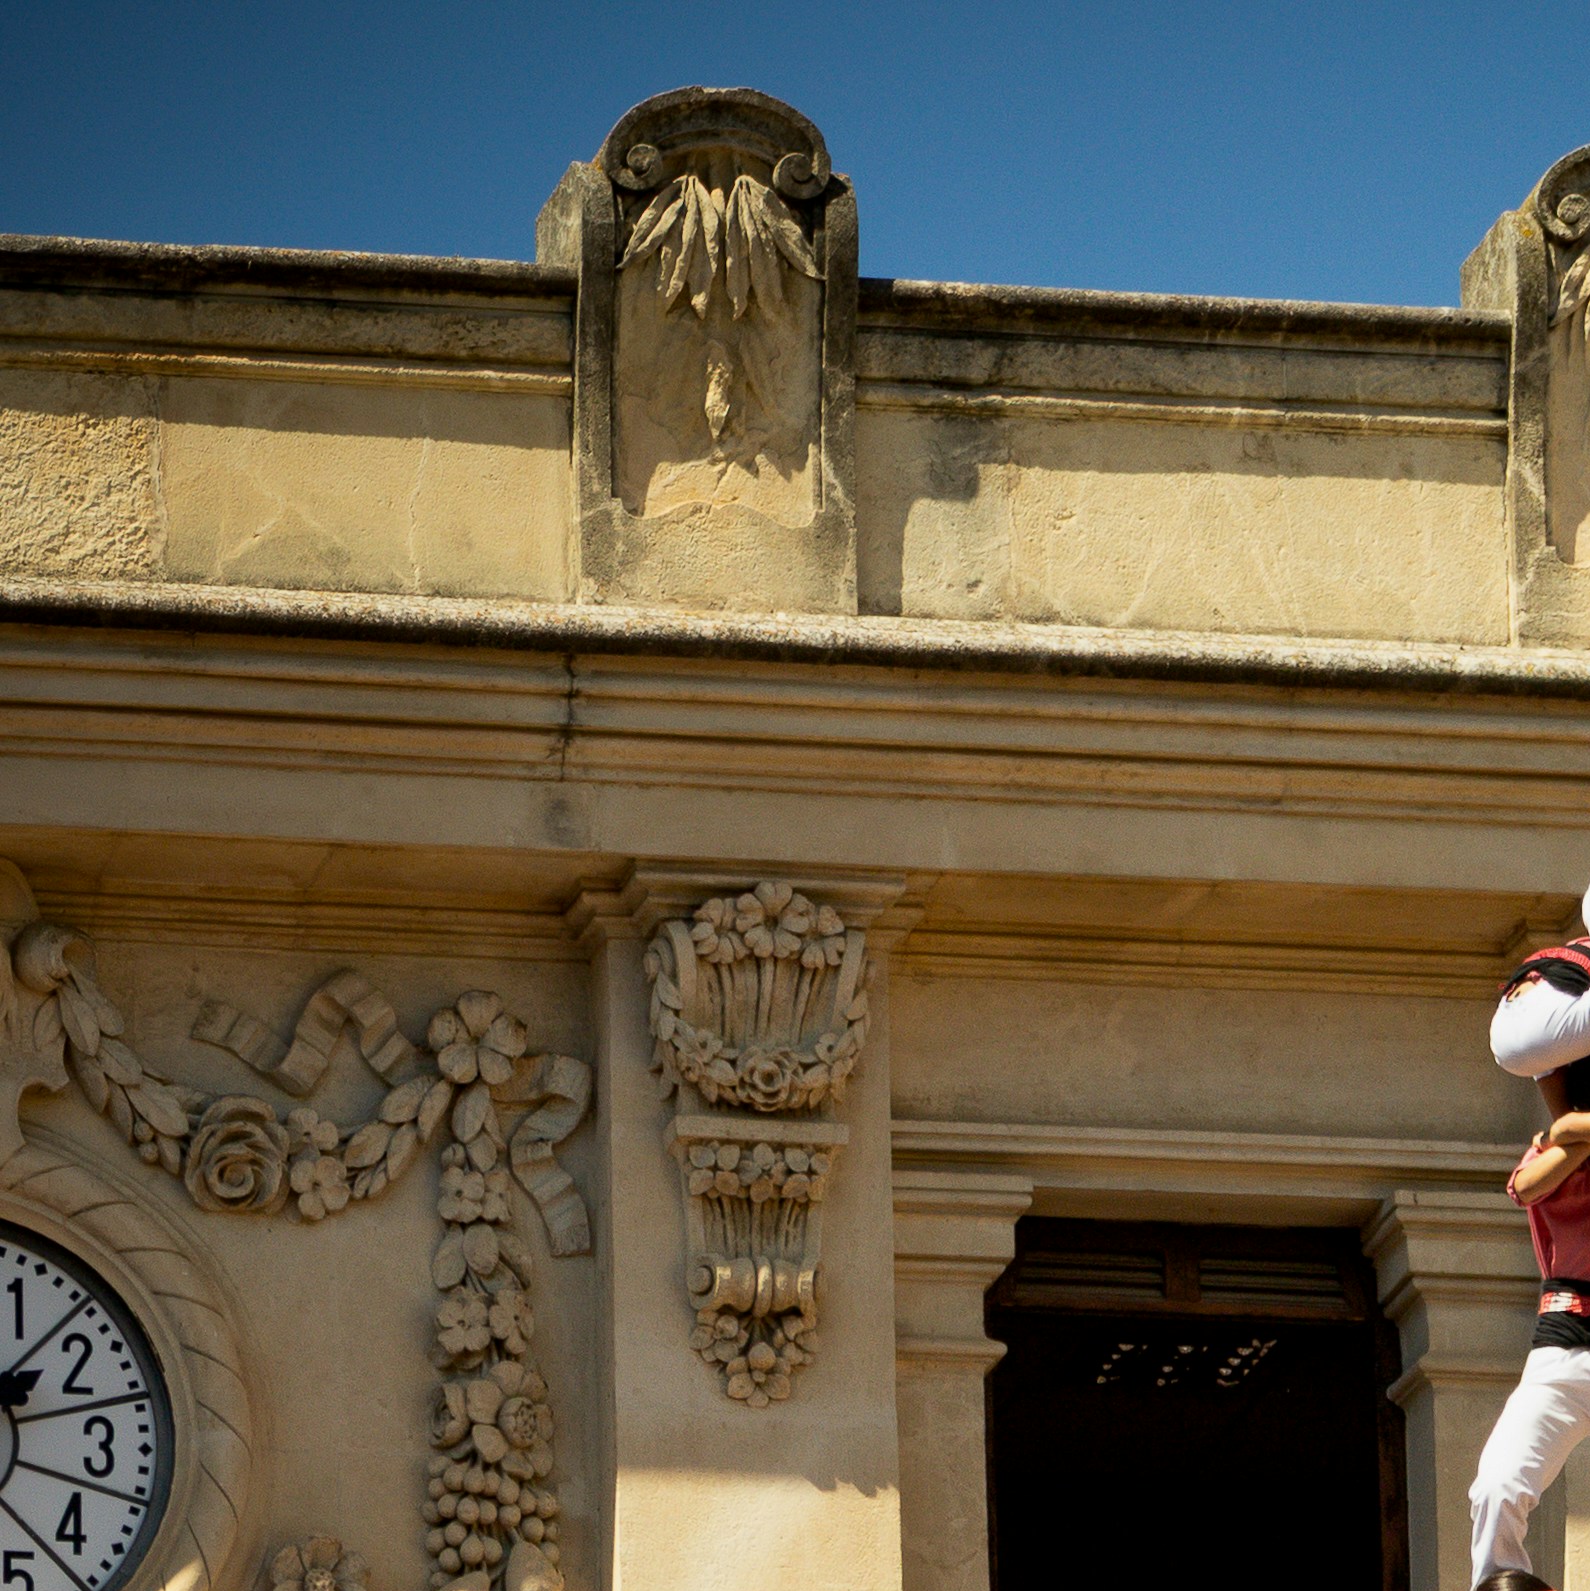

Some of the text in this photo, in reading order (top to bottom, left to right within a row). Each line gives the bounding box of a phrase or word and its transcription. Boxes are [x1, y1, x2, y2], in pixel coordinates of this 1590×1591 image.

[6, 1277, 24, 1340] 1
[62, 1333, 94, 1396] 2
[82, 1416, 115, 1479] 3
[55, 1492, 87, 1556] 4
